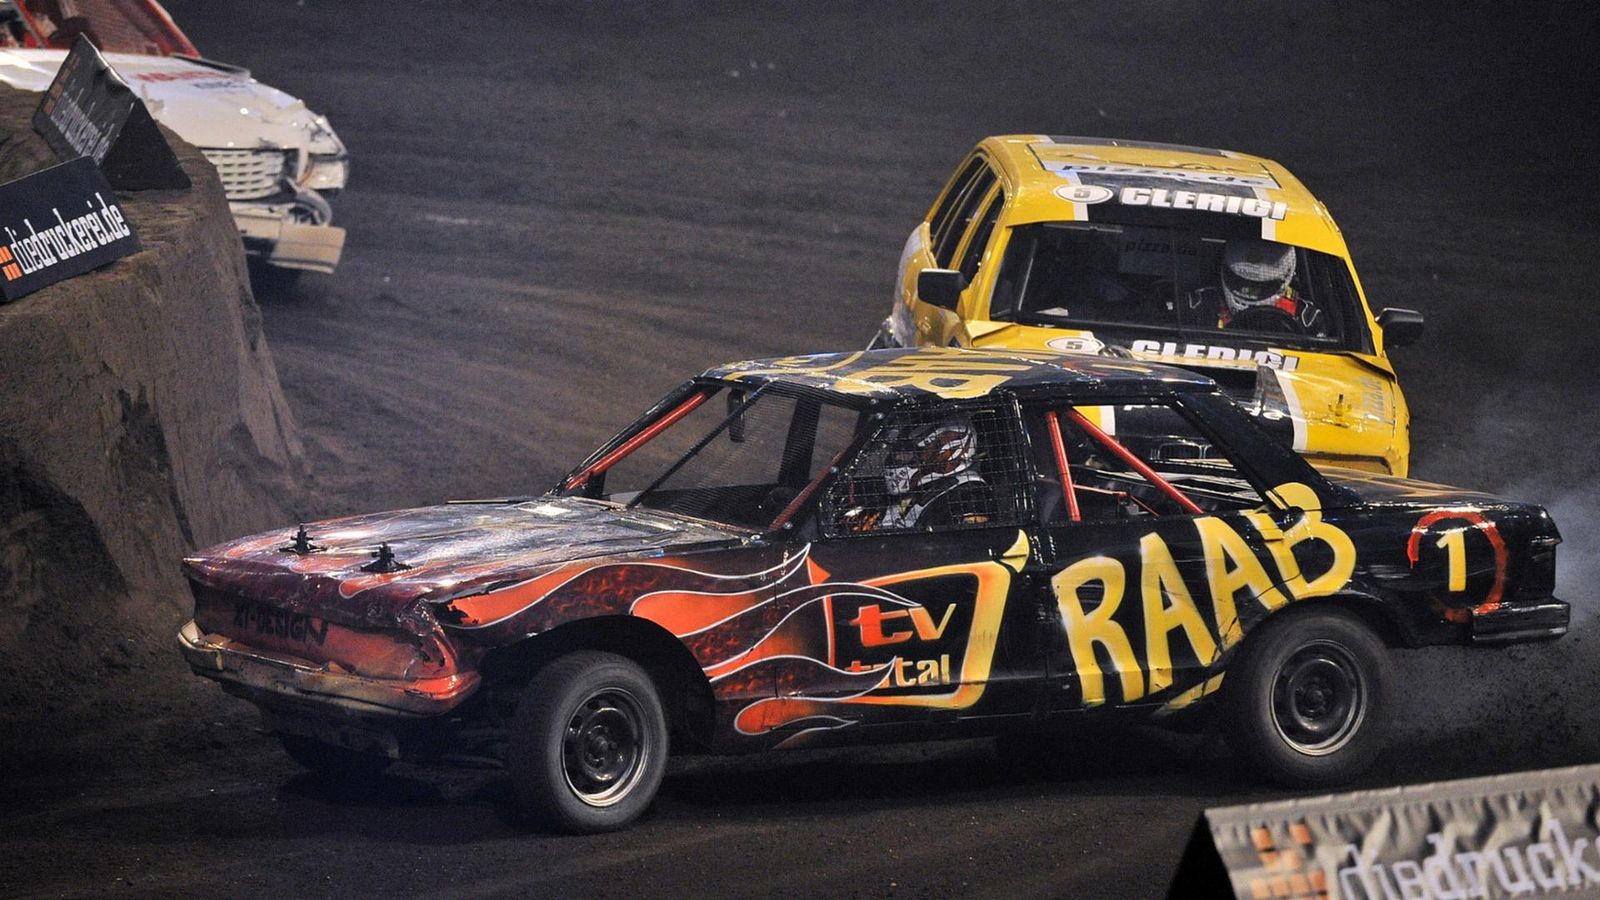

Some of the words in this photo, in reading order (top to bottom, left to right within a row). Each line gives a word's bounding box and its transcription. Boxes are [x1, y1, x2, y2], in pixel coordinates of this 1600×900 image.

[4, 191, 131, 275] diedruckerei.de
[1120, 187, 1288, 221] CLERIGI
[1436, 530, 1467, 592] 1
[1051, 482, 1357, 706] RAAB
[851, 603, 957, 648] tv
[844, 654, 950, 689] ttal
[1338, 818, 1600, 900] diedruck
